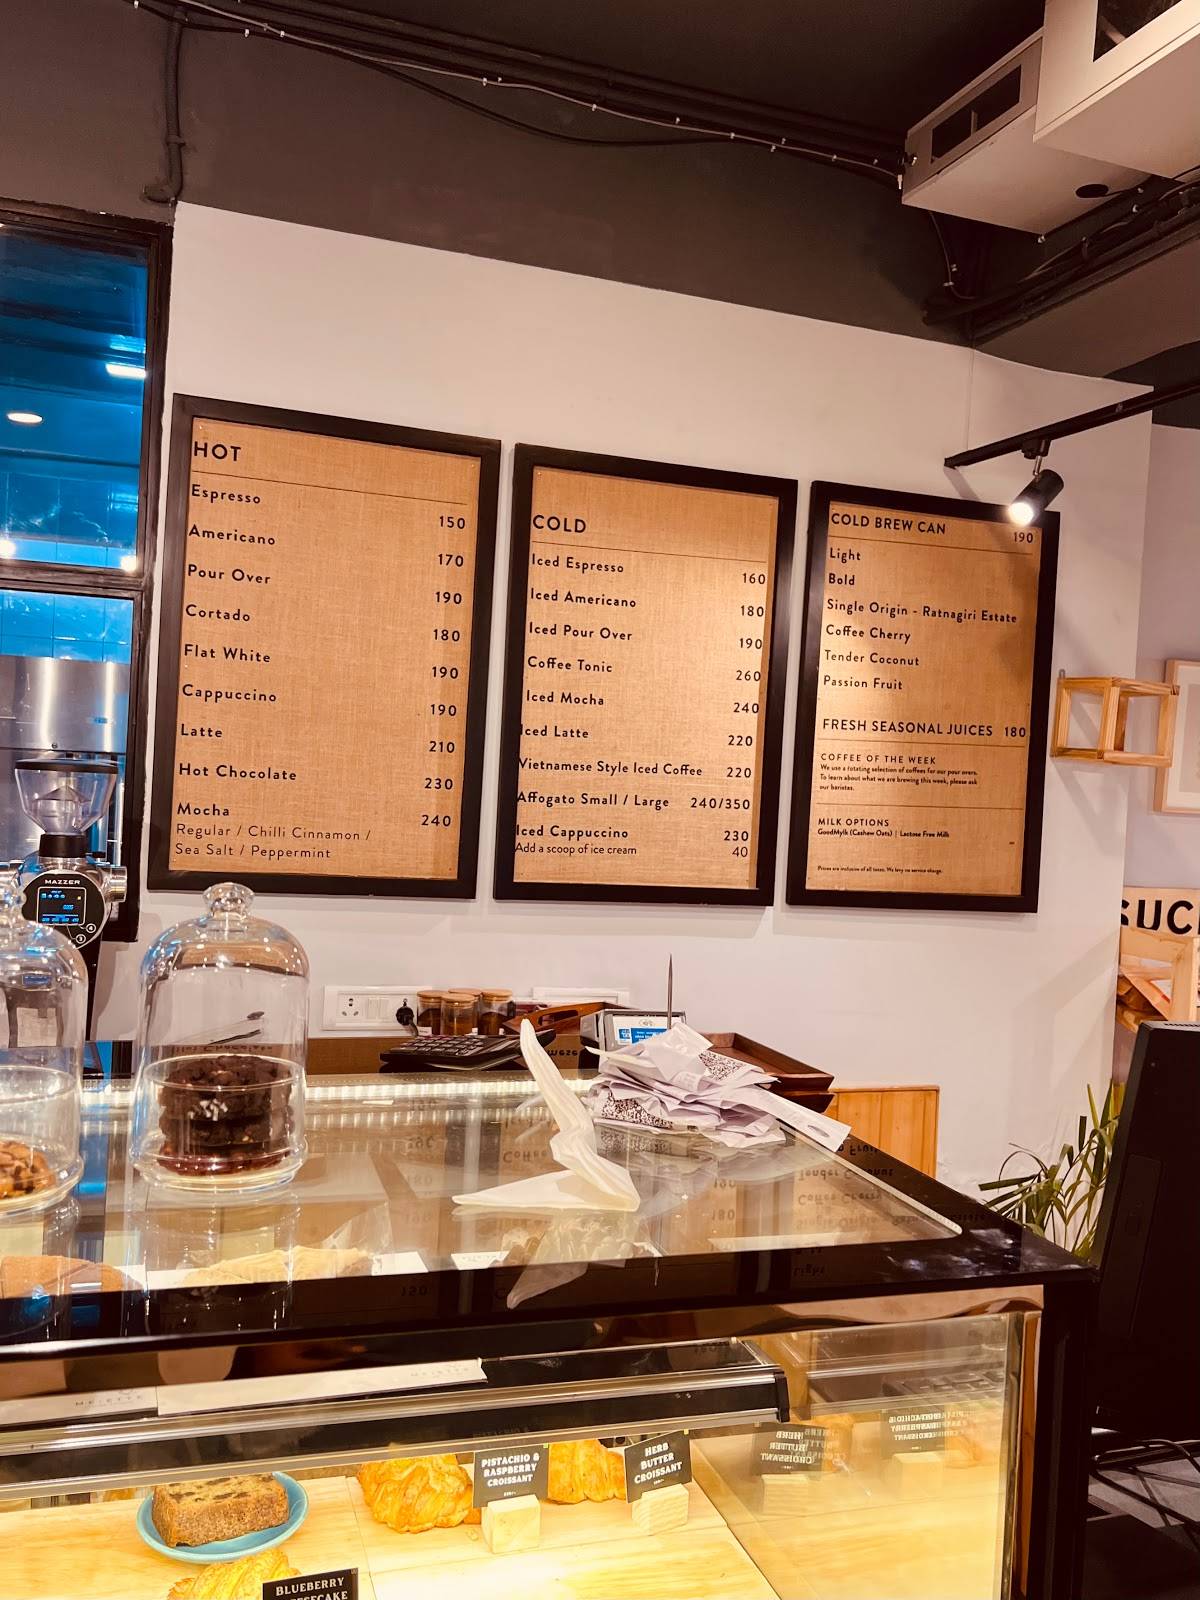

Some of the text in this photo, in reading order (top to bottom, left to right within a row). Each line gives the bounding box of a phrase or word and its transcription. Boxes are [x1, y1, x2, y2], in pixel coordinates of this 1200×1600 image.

[194, 441, 242, 462] HOT
[192, 484, 466, 530] Espresso 150
[533, 514, 586, 534] COLD
[831, 513, 1034, 544] COLD BREW CAN 190
[189, 524, 464, 567] Americano 170
[830, 547, 860, 564] Light
[532, 553, 766, 584] Iced Espresso 160
[188, 564, 462, 605] Pour Over 190
[828, 572, 855, 586] Bold
[531, 588, 764, 617] Iced Americano 180
[827, 598, 864, 616] Single
[869, 602, 908, 618] Origin
[922, 605, 976, 624] Ratnagiri
[981, 610, 1016, 623] Estate
[186, 604, 460, 642] Cortado 180
[530, 622, 762, 650] Iced Pour Over 190
[826, 624, 911, 645] Coffee Cherry
[184, 644, 458, 679] Flat White 190
[824, 649, 919, 666] Tender Coconut
[528, 656, 761, 682] Coffee Tonic 260
[824, 674, 902, 690] Passion Fruit
[182, 684, 457, 716] Cappuccino 190
[527, 690, 760, 714] Iced Mocha 240
[520, 724, 753, 746] Iced Latte 220
[823, 718, 1026, 738] FRESH SEASONAL JUICES 180
[181, 723, 455, 754] Latte 210
[519, 758, 752, 778] Vietnamese Style Iced Coffee 220
[820, 753, 936, 764] COFFEE OF THE WEEK
[179, 763, 453, 790] Hot Chocolate 230
[896, 776, 920, 786] brewing
[950, 778, 967, 786] please
[517, 791, 750, 811] Affogato Small / Large 240/350
[177, 802, 451, 827] Mocha 240
[818, 818, 889, 827] MILK OPTIONS
[176, 823, 371, 841] Regular / Chilli Cinnamon /
[516, 824, 749, 842] Iced Cappuccino 230
[176, 842, 331, 861] Sea Salt / Peppermint
[515, 842, 536, 854] Add
[546, 846, 576, 857] scoop
[577, 843, 590, 854] of
[590, 843, 605, 854] ice
[732, 846, 748, 858] 40
[1121, 900, 1200, 934] UC
[645, 1442, 669, 1456] HERB
[482, 1454, 530, 1467] PISTACHIO
[484, 1462, 537, 1478] RASPBERRY
[640, 1452, 675, 1470] BUTTER
[487, 1474, 533, 1486] CROISSANT
[634, 1462, 682, 1484] CROISSANT
[276, 1577, 344, 1596] BLUEBERRY
